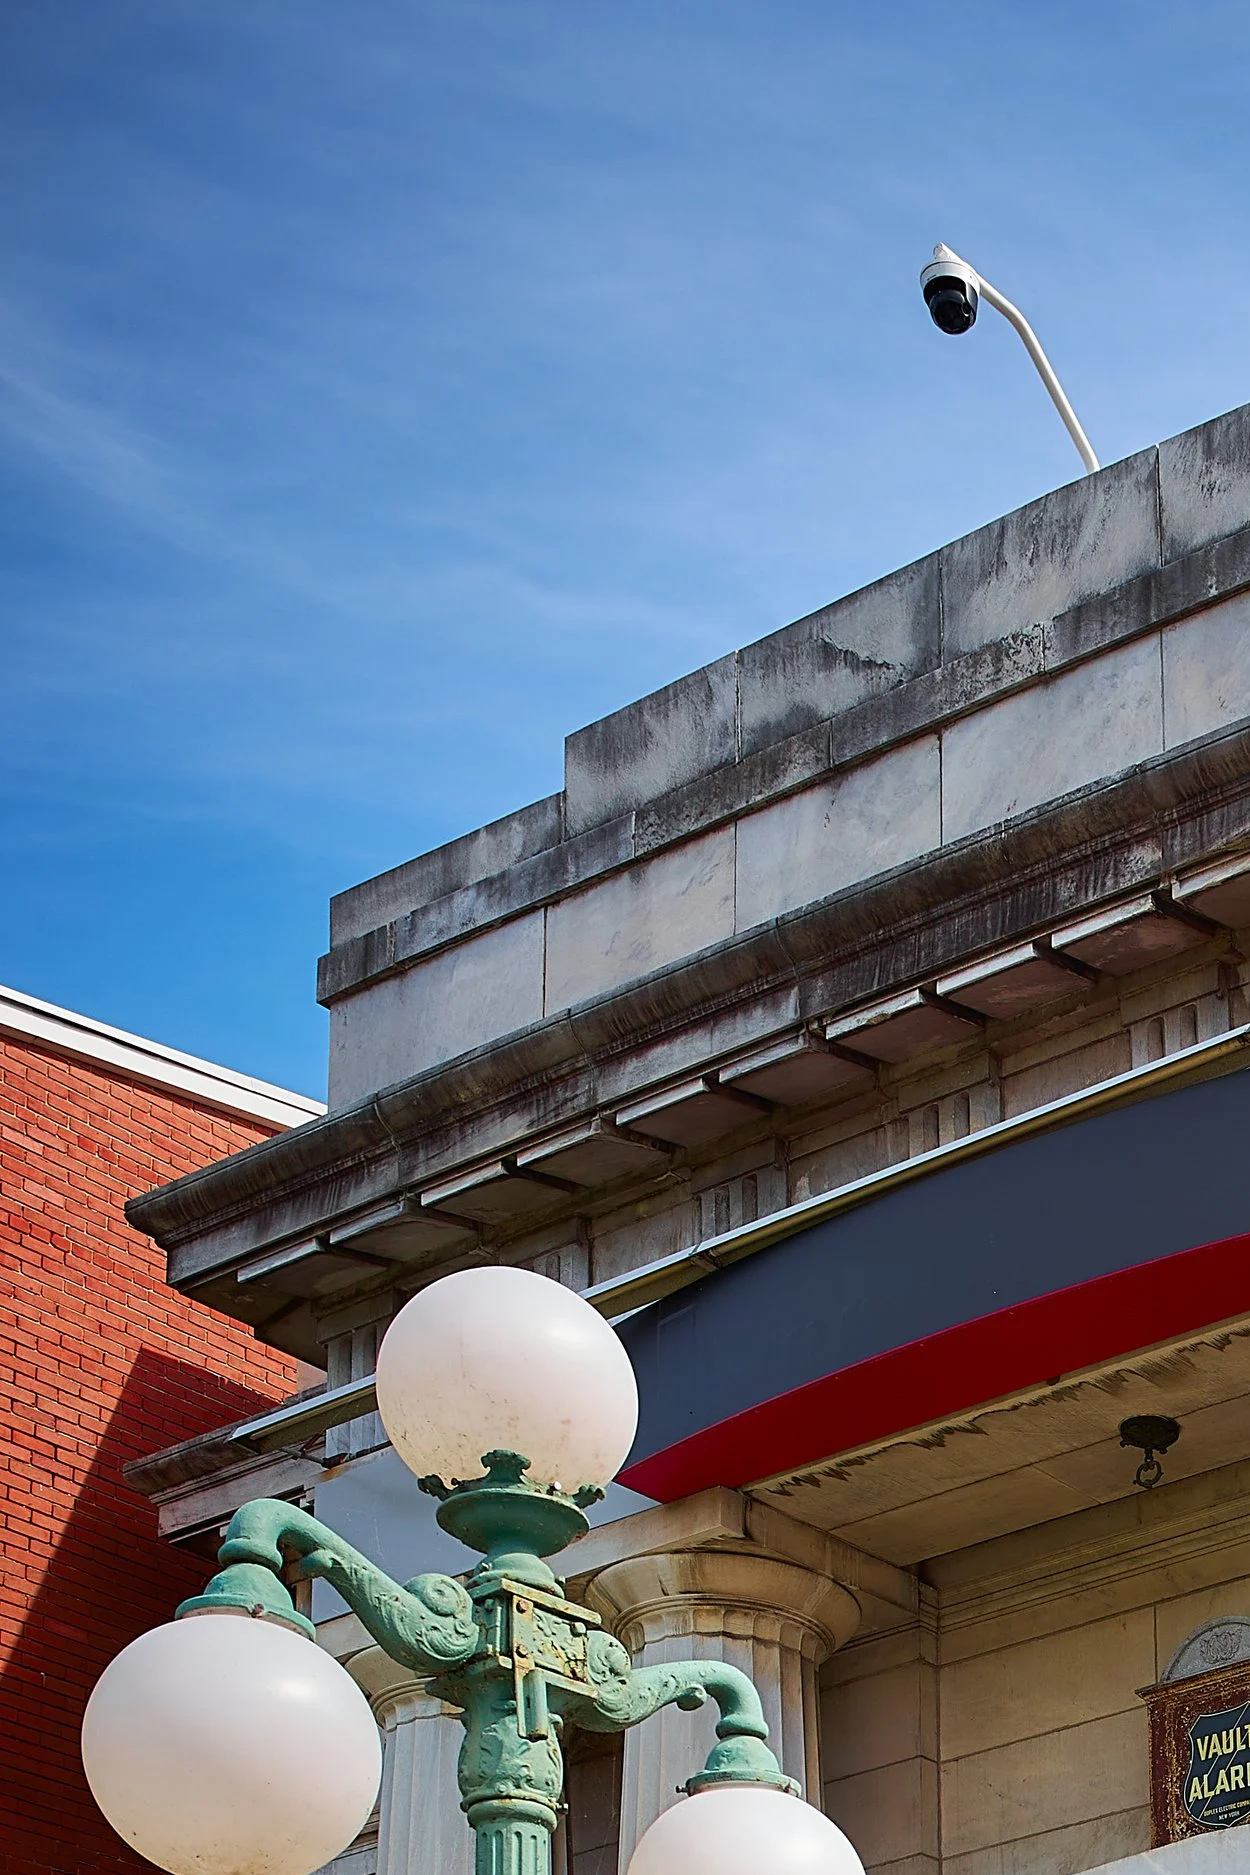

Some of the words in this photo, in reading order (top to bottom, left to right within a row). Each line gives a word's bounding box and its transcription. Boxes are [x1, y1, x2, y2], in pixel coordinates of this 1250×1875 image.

[1203, 1808, 1219, 1817] DUPLEX
[1218, 1803, 1237, 1813] ELECTRIC
[1218, 1813, 1228, 1821] NEW
[1228, 1810, 1241, 1818] YORK
